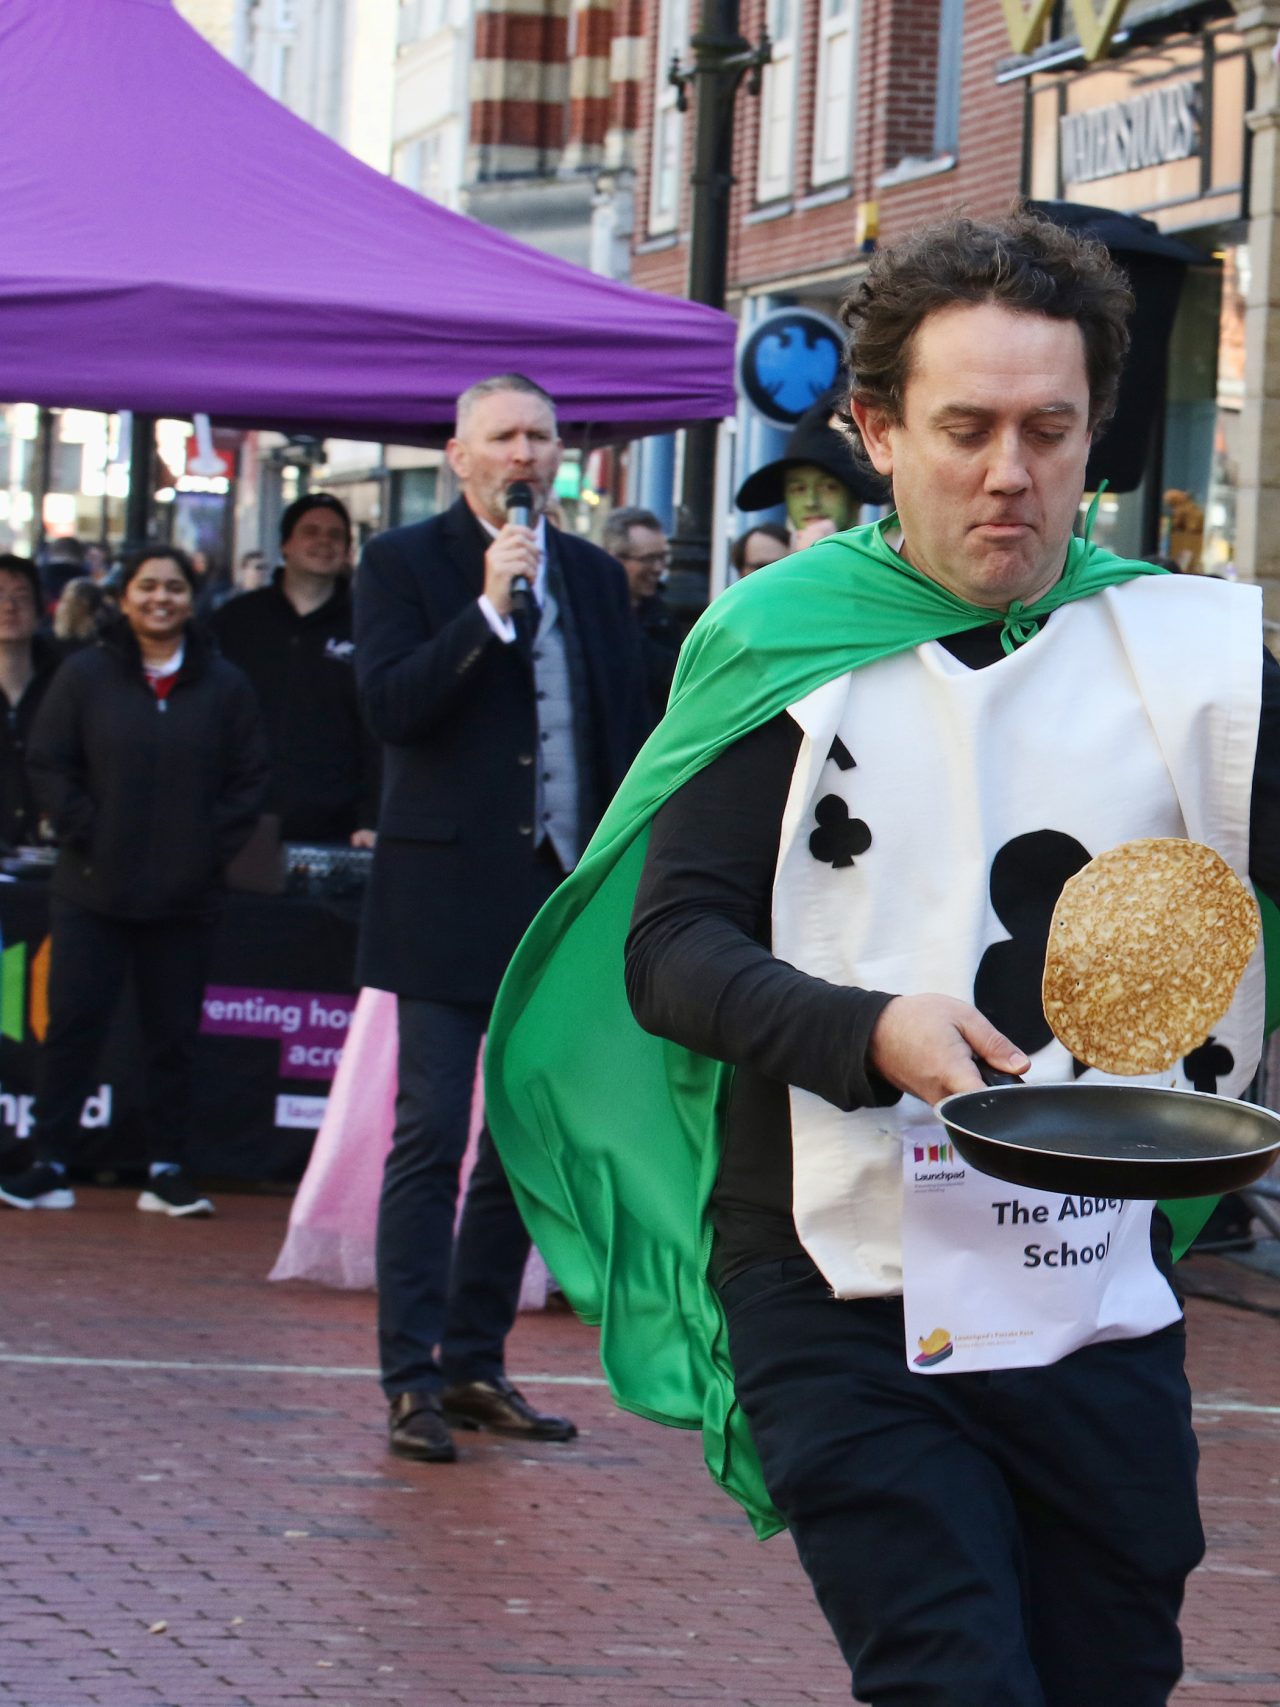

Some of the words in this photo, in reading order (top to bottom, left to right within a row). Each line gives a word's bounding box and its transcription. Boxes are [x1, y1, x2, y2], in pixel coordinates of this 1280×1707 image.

[914, 1170, 966, 1182] Launchpad
[991, 1200, 1050, 1225] The
[1057, 1195, 1125, 1222] Abbey
[1023, 1231, 1111, 1268] School
